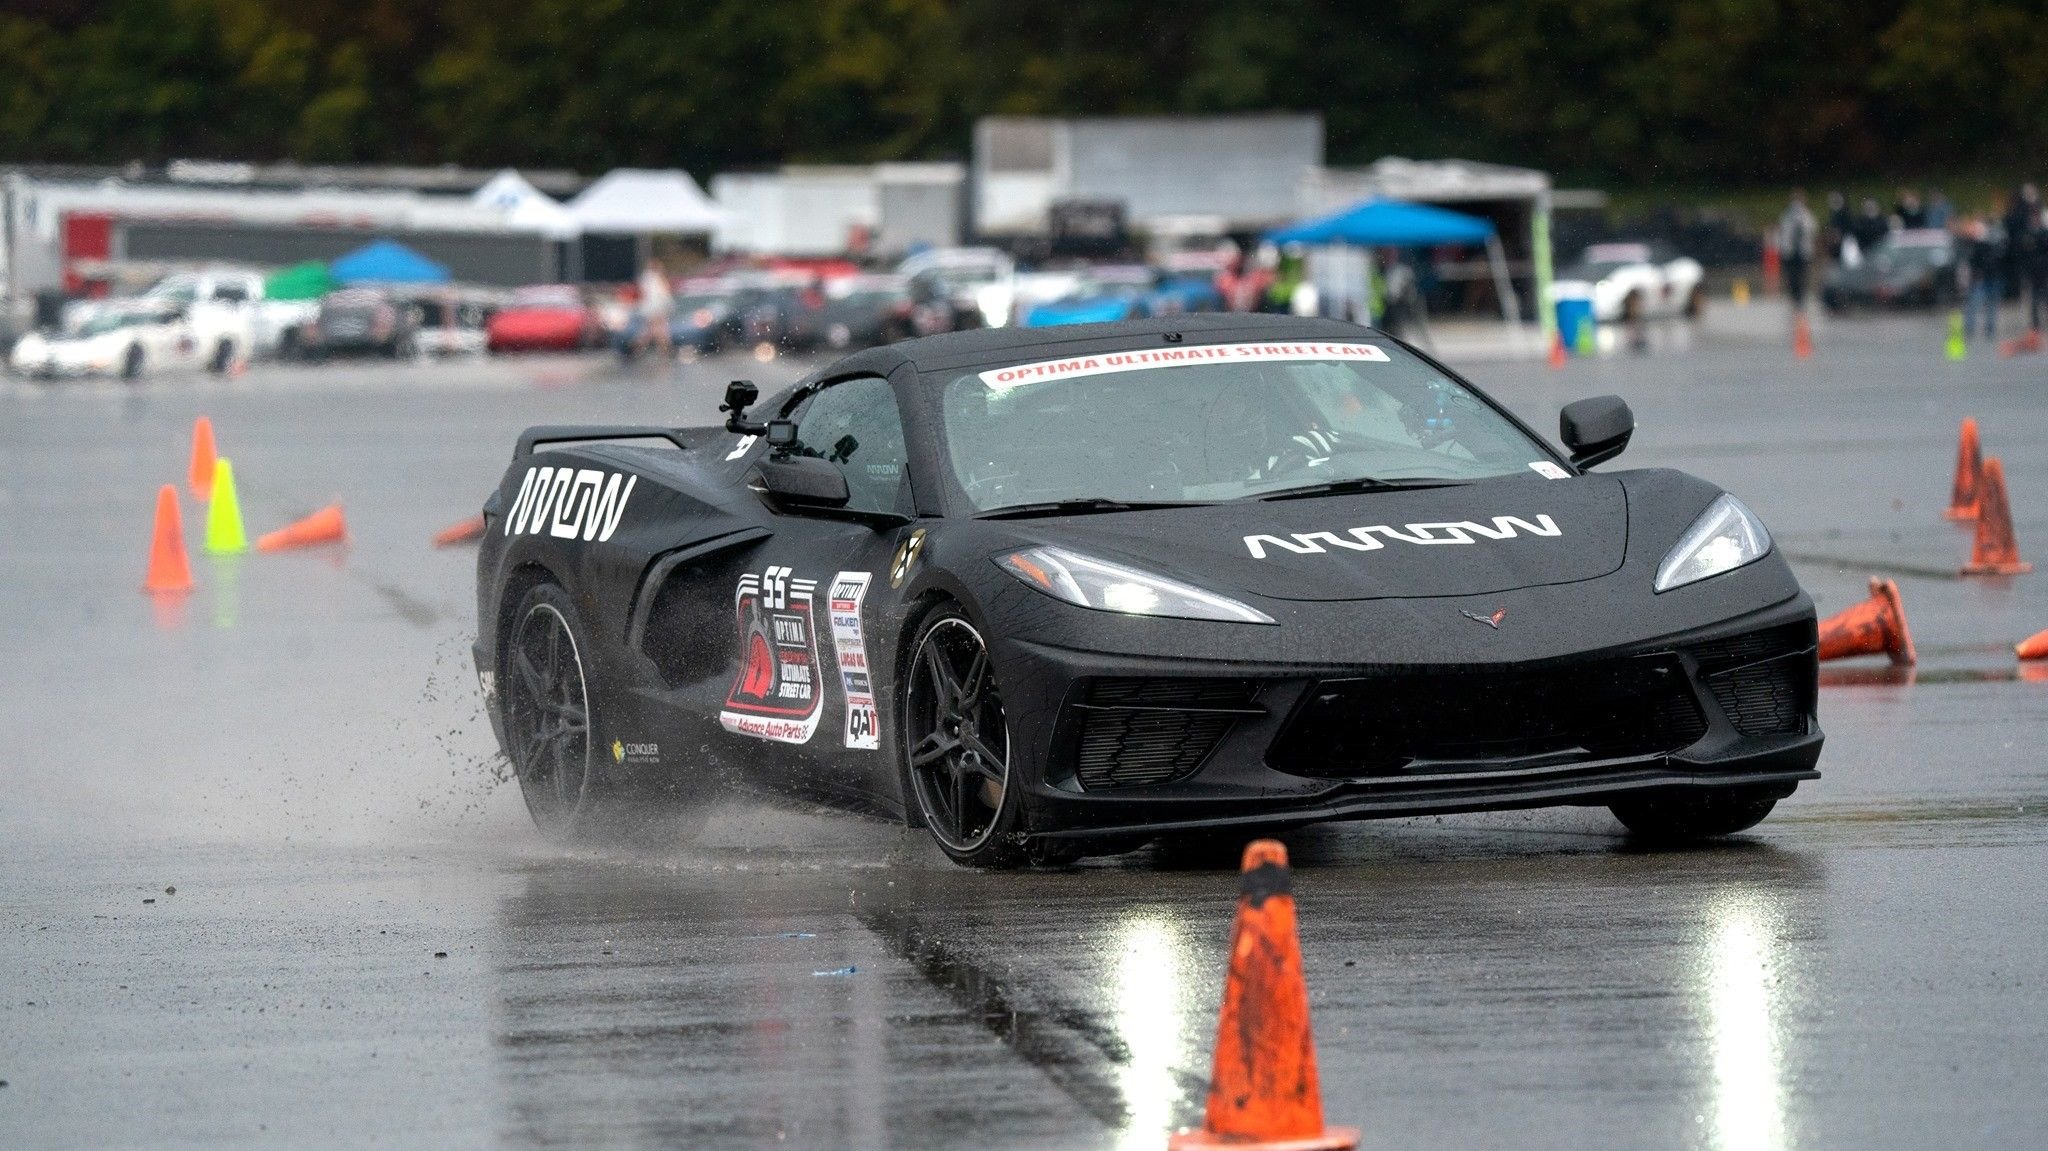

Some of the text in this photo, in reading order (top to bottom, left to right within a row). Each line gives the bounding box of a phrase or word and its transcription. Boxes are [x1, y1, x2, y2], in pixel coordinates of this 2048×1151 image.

[997, 345, 1375, 383] OPTIMA ULTIMATE STREET CAR
[775, 620, 805, 642] OPTIMA
[781, 663, 811, 683] ULTIMATE
[778, 682, 812, 700] STREET CAR
[737, 718, 765, 736] Advance
[765, 721, 783, 738] Auto
[782, 723, 802, 739] Parts
[626, 743, 659, 755] CONQUER
